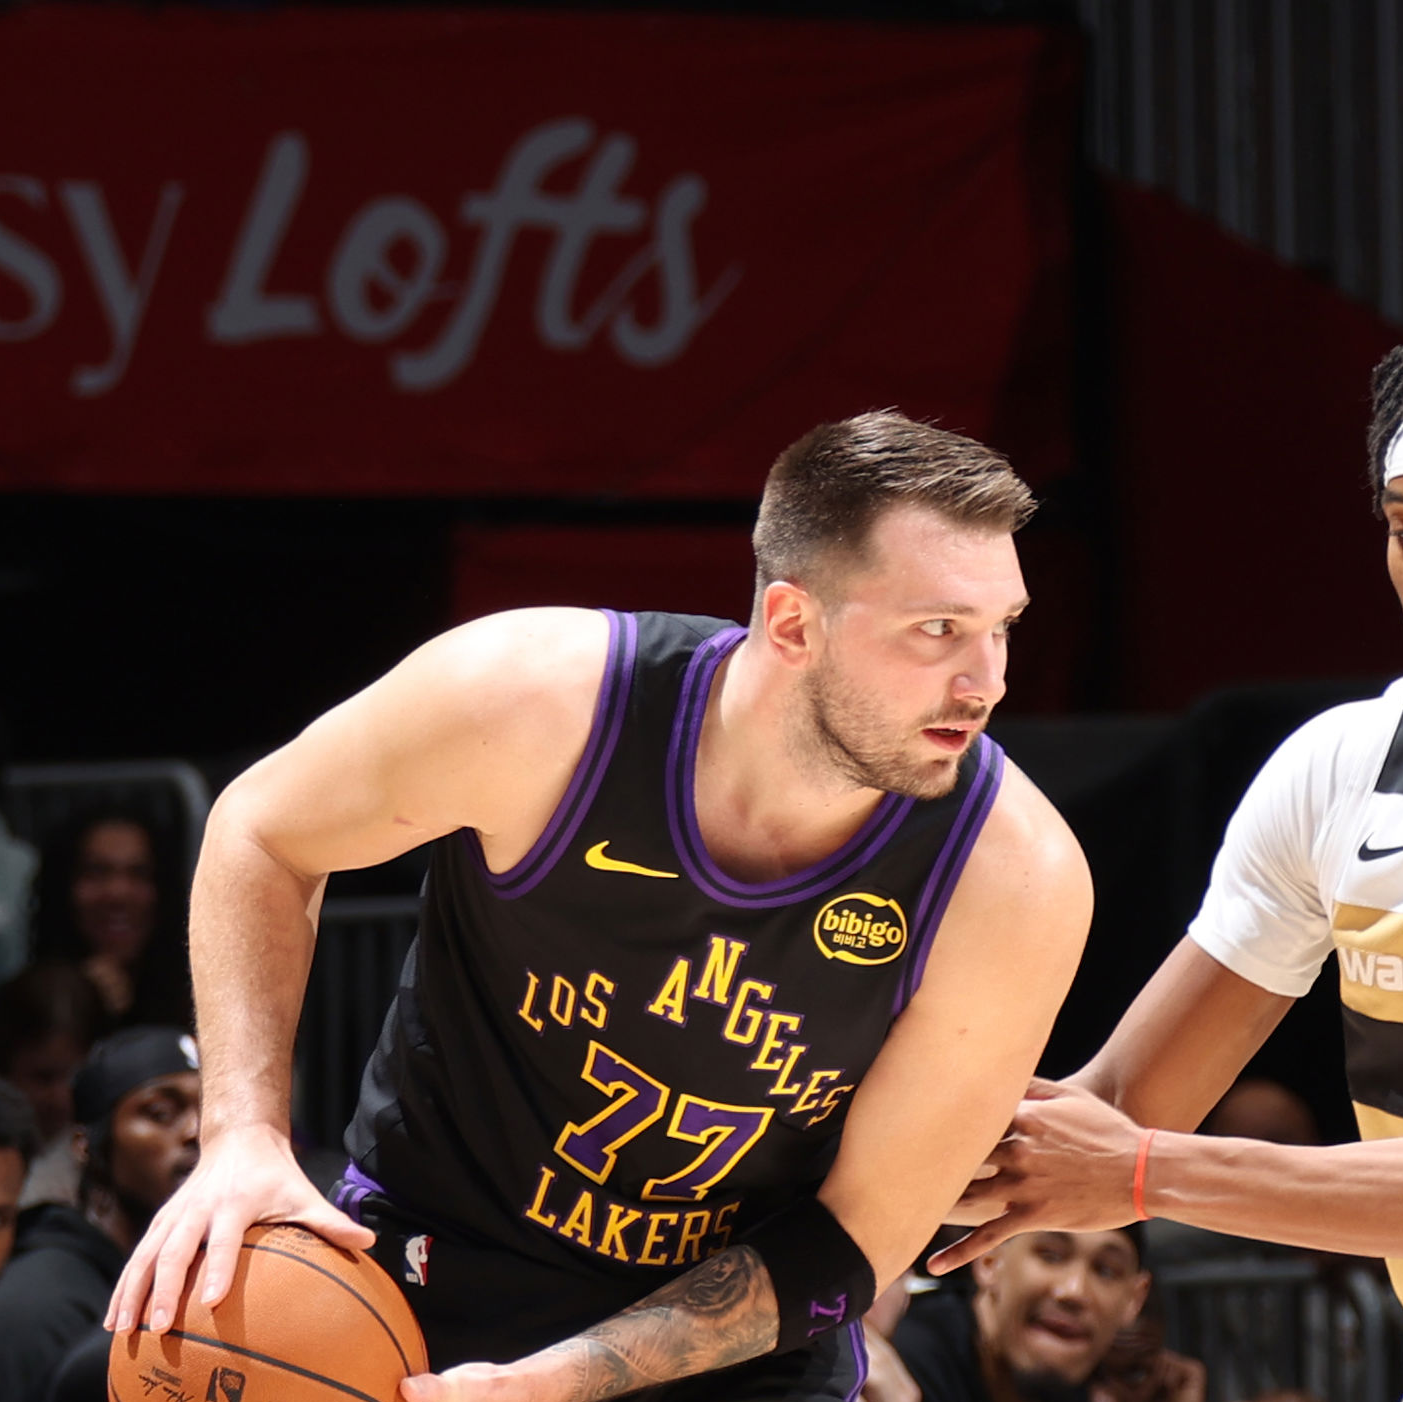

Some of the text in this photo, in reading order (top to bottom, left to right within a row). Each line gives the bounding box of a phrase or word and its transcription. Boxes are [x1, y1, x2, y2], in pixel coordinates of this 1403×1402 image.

[207, 115, 742, 391] Lofts
[823, 909, 902, 947] bibigo
[832, 932, 867, 949] 비비고
[517, 933, 856, 1129] LOS ANGELES
[553, 1039, 775, 1202] 77
[524, 1164, 742, 1266] LAKERS
